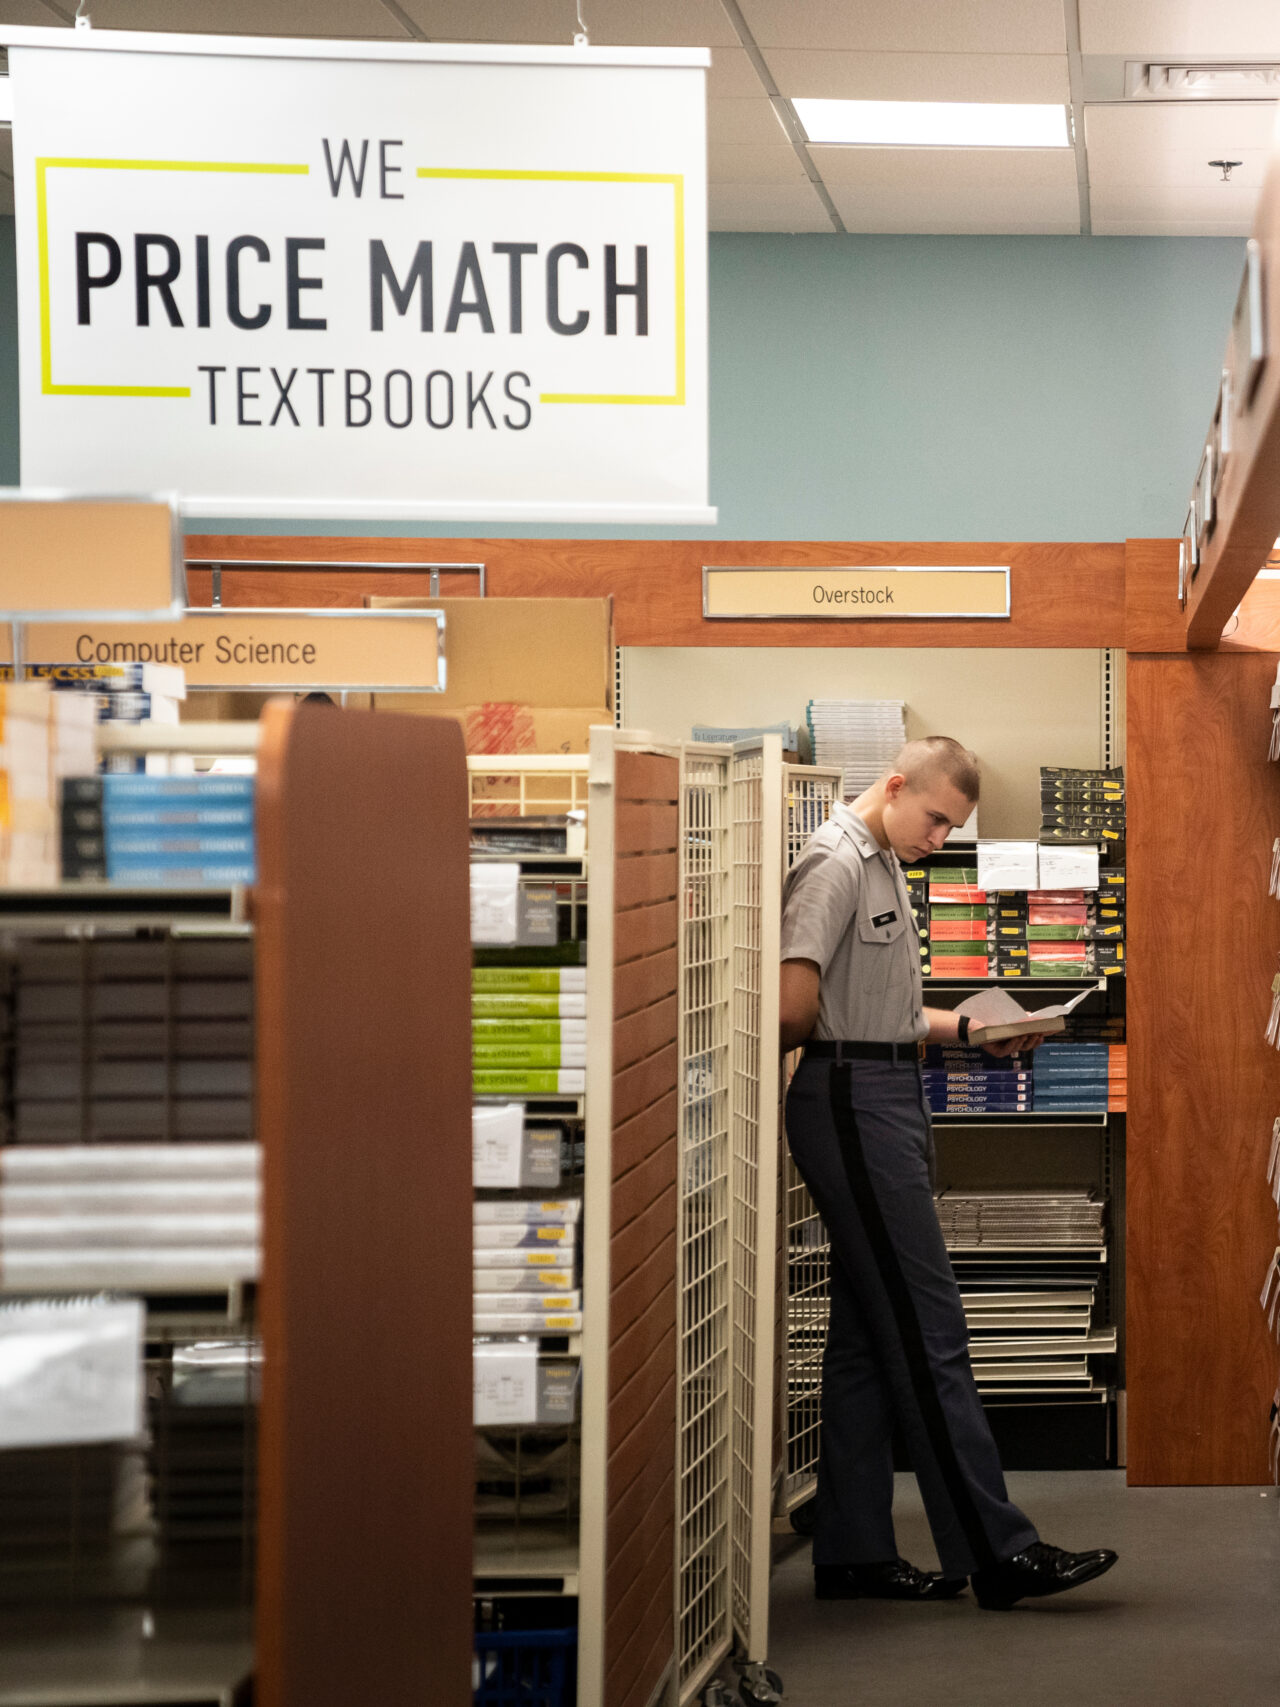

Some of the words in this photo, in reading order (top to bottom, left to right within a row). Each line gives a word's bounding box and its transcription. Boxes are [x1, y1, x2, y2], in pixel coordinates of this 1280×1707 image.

[321, 138, 405, 200] WE
[74, 231, 328, 331] PRICE
[368, 238, 650, 337] MATCH
[197, 365, 533, 431] TEXTBOOKS
[812, 585, 895, 604] Overstock
[75, 634, 205, 664] Computer
[214, 635, 317, 665] Science
